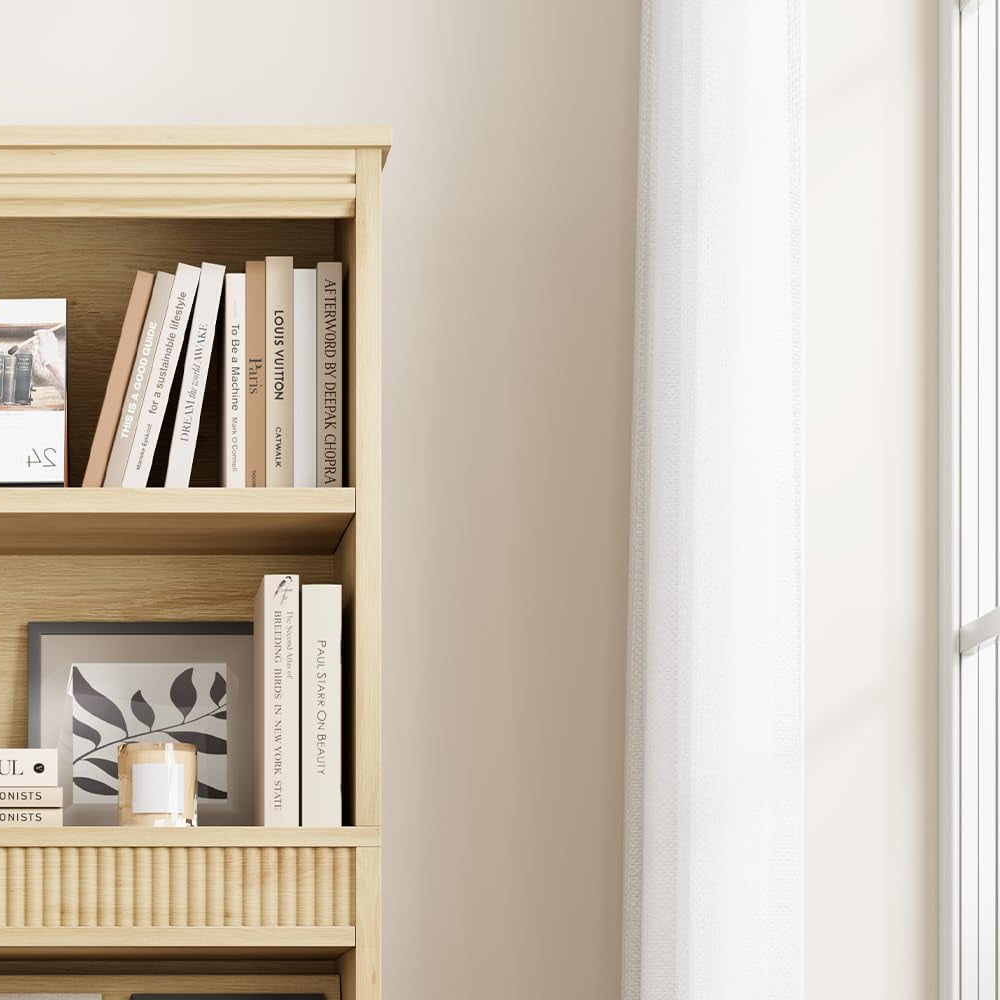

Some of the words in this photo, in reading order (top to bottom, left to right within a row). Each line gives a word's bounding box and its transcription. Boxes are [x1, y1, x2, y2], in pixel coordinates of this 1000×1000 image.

[232, 324, 240, 336] To
[274, 311, 284, 345] LOUIS
[325, 279, 336, 358] AFTERWORD
[148, 401, 158, 414] for
[157, 330, 176, 389] sustainable
[169, 291, 187, 330] lifestyle
[194, 323, 208, 361] AWAKE
[232, 340, 240, 353] Be
[121, 415, 133, 438] THIS
[128, 402, 136, 413] IS
[134, 358, 147, 390] GOOD
[142, 321, 157, 356] GUIDE
[190, 363, 200, 387] world
[249, 359, 262, 394] Paris
[275, 350, 284, 399] VUITTON
[325, 363, 336, 378] BY
[188, 386, 197, 398] the
[232, 367, 240, 411] Machine
[324, 383, 336, 429] DEEPAK
[181, 400, 195, 442] DREAM
[273, 426, 282, 468] CATWALK
[325, 434, 336, 484] CHOPRA
[286, 611, 294, 624] The
[286, 671, 294, 679] of
[275, 705, 281, 714] IN
[274, 720, 282, 743] NEW
